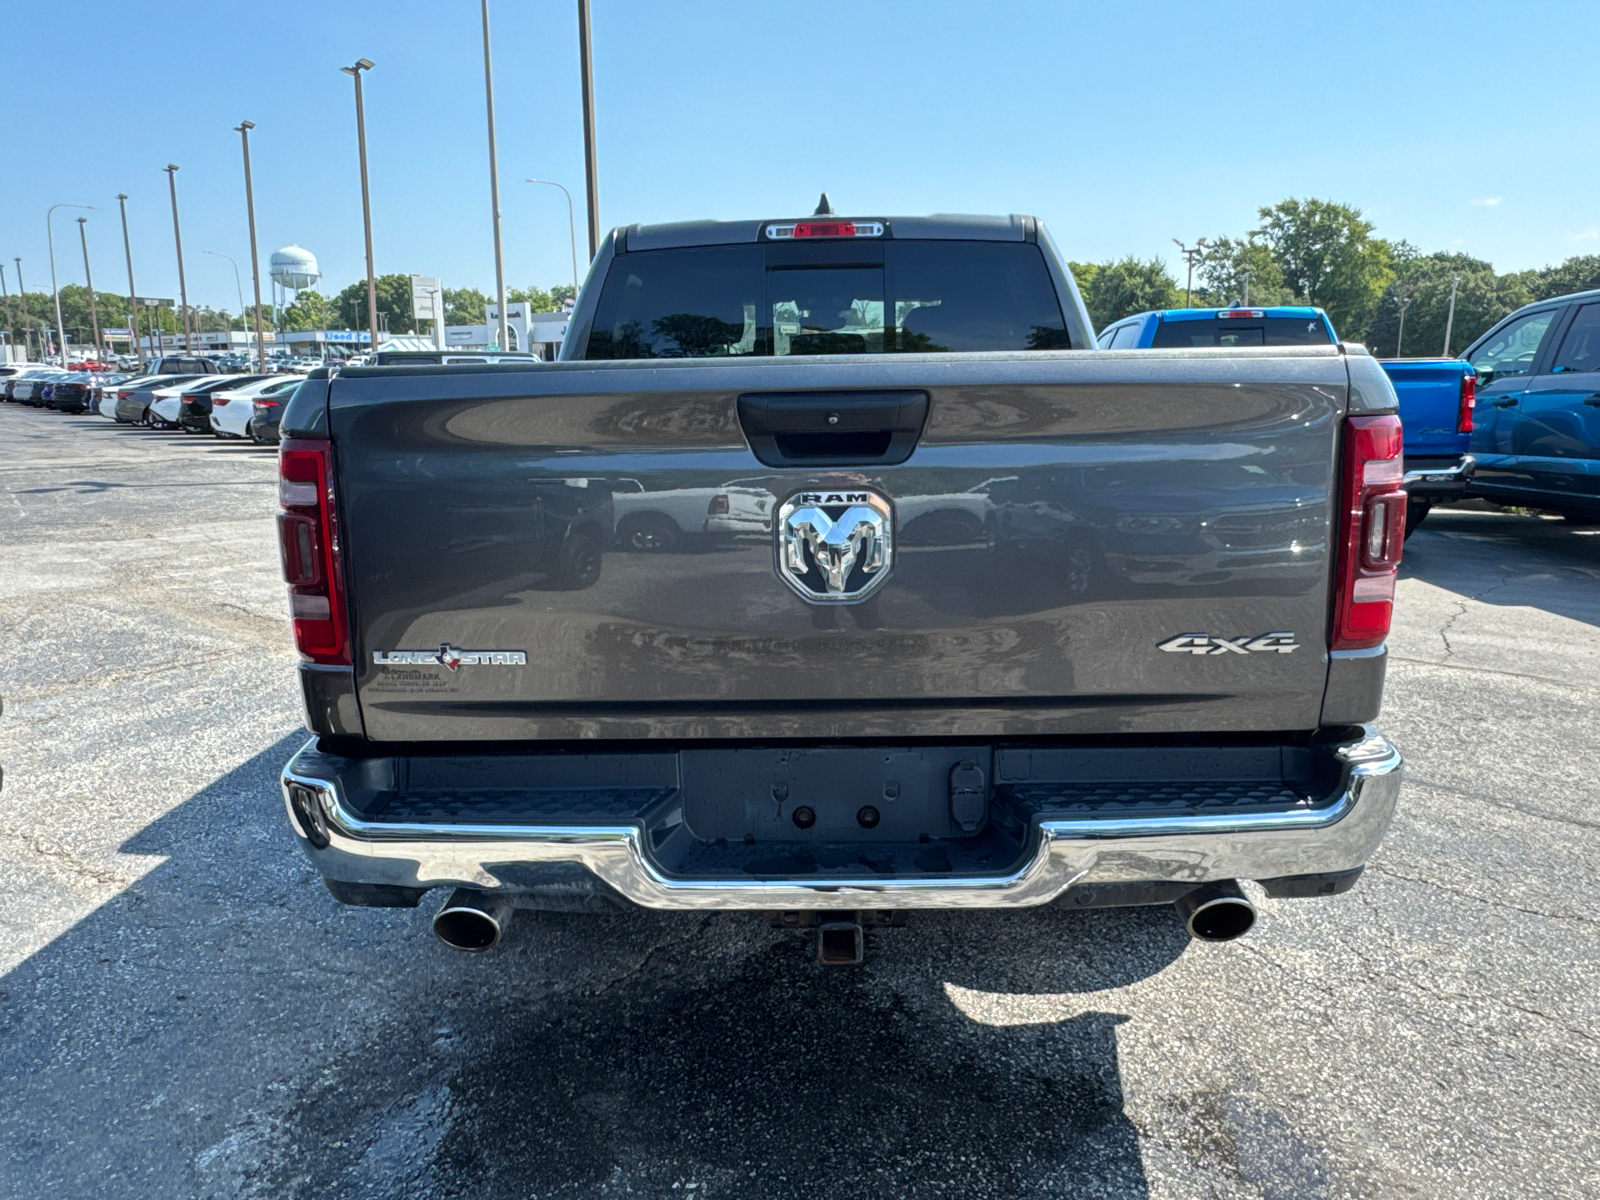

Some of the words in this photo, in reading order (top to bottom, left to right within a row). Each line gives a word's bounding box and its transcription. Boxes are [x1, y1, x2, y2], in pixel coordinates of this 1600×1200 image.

[325, 332, 352, 340] Used
[801, 494, 867, 503] RAM
[373, 650, 437, 665] LONE
[460, 651, 528, 666] STAR
